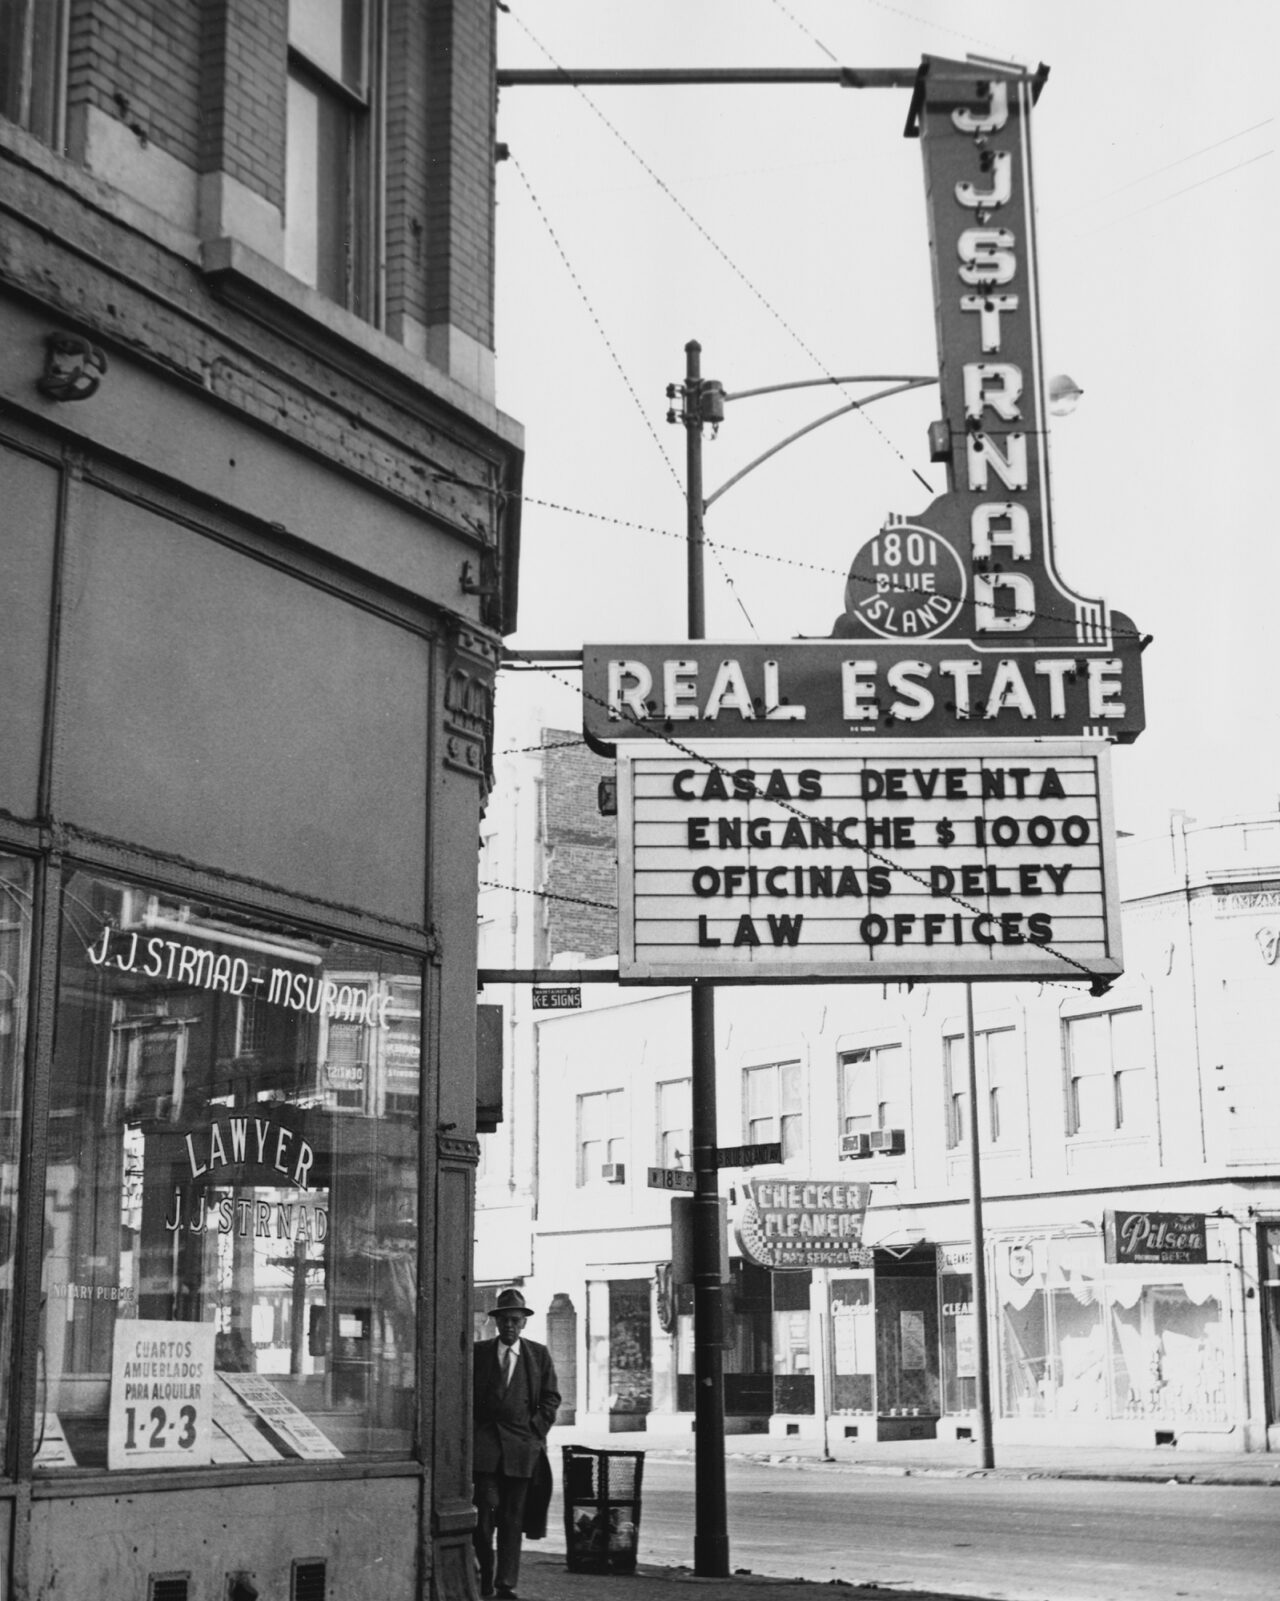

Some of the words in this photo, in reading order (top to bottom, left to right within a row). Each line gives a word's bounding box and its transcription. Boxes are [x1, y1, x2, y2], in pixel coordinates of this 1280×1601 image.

[872, 533, 937, 567] 1801
[876, 573, 935, 593] BLUE
[859, 594, 952, 633] ISLAND
[607, 659, 806, 721] REAL
[841, 658, 1126, 721] ESTATE
[672, 768, 822, 801] CASAS
[687, 816, 916, 849] ENGANCHE
[975, 814, 1090, 847] 1000
[692, 865, 892, 898] OFICINAS
[697, 914, 803, 947] LAW
[860, 912, 1053, 946] OFFICES
[551, 994, 580, 1007] SIGNS
[184, 1116, 314, 1191] LAWYER
[758, 1184, 861, 1209] CHECKER
[218, 1197, 328, 1243] STRNAD
[765, 1213, 862, 1237] CLEANERS
[1120, 1214, 1203, 1253] Pilsen
[53, 1283, 93, 1299] NOTARY
[97, 1285, 135, 1301] PUBLIC
[136, 1341, 192, 1359] CUARTOS
[124, 1362, 203, 1378] AMUEBLADOS
[125, 1383, 149, 1400] PARA
[152, 1382, 201, 1400] ALQUILAR
